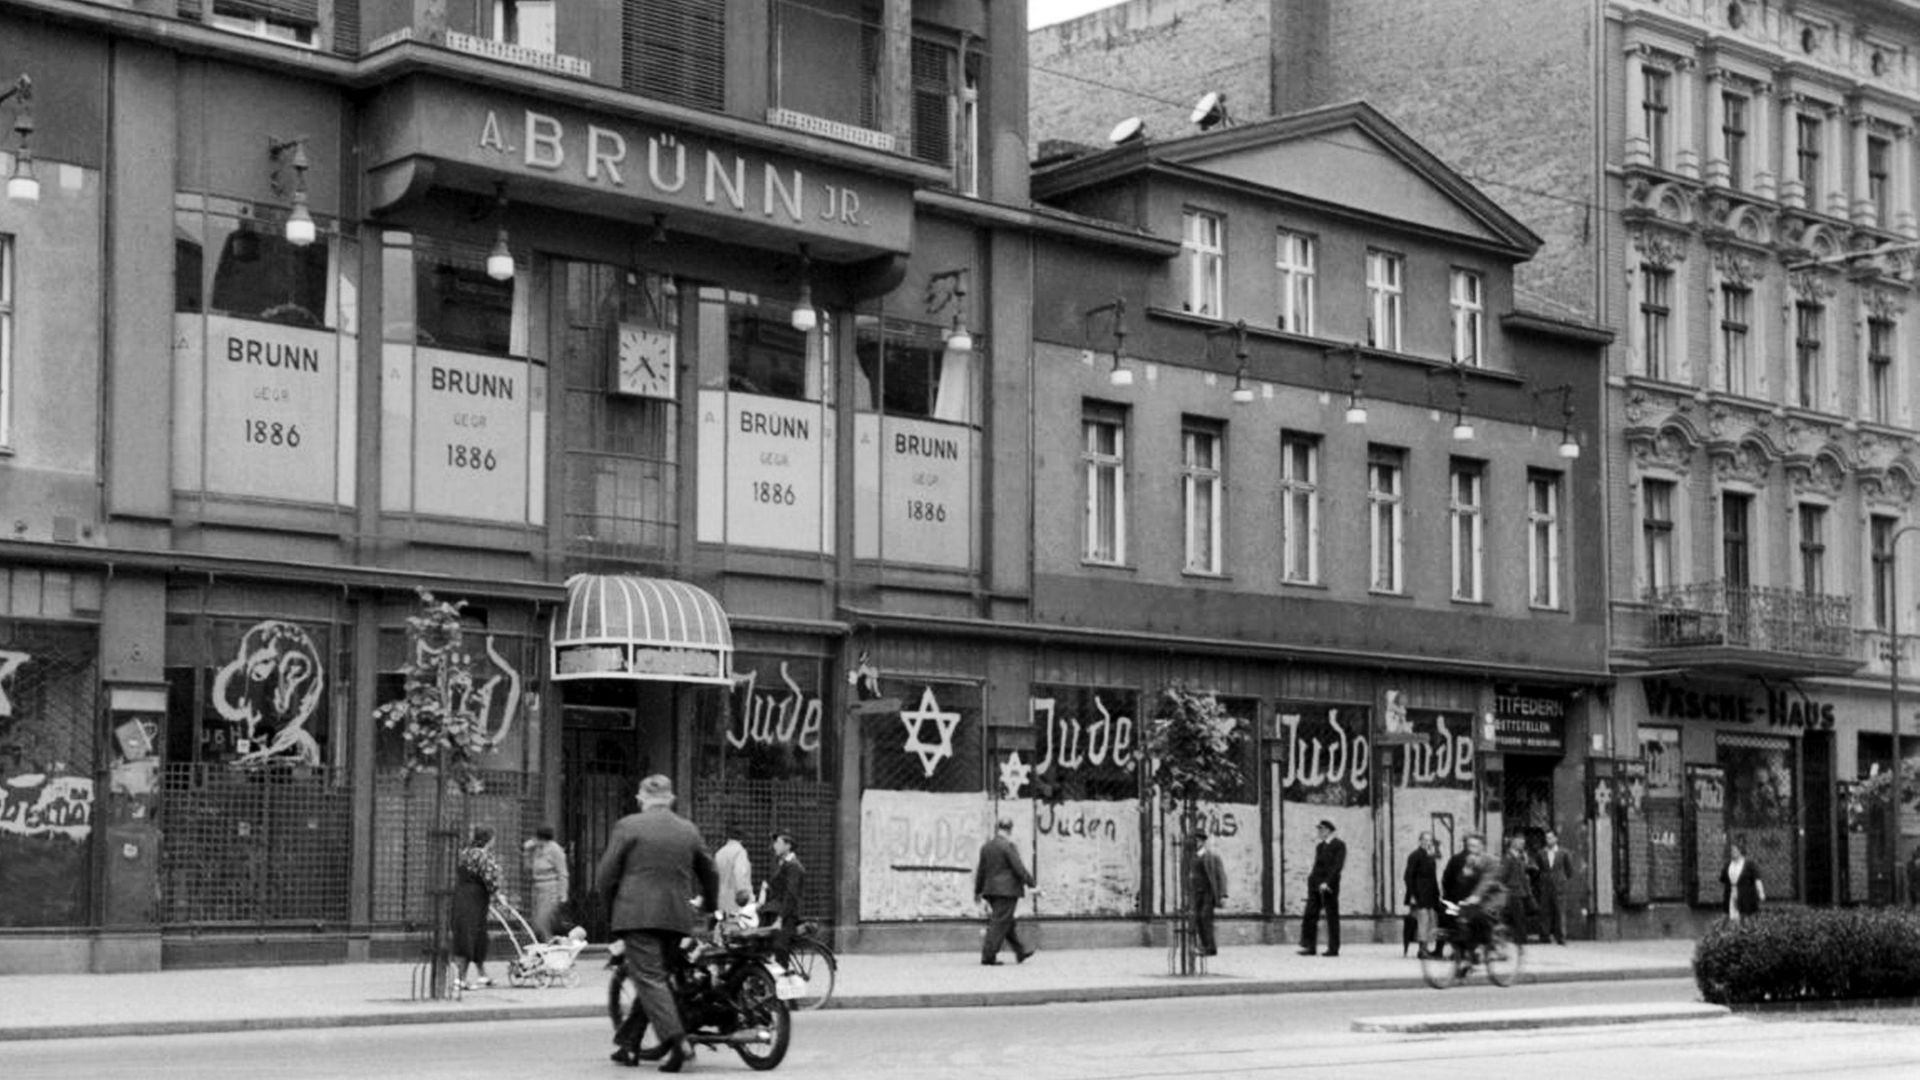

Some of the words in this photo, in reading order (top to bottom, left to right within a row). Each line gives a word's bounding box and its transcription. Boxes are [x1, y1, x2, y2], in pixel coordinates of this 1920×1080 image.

[524, 109, 804, 222] BRÜNN
[245, 418, 301, 448] 1886
[448, 443, 496, 472] 1886
[752, 480, 796, 506] 1886
[907, 499, 946, 522] 1886
[726, 660, 823, 751] Jude
[1034, 696, 1133, 774] Jude
[1282, 708, 1369, 791] Jude
[1037, 799, 1117, 843] Juden
